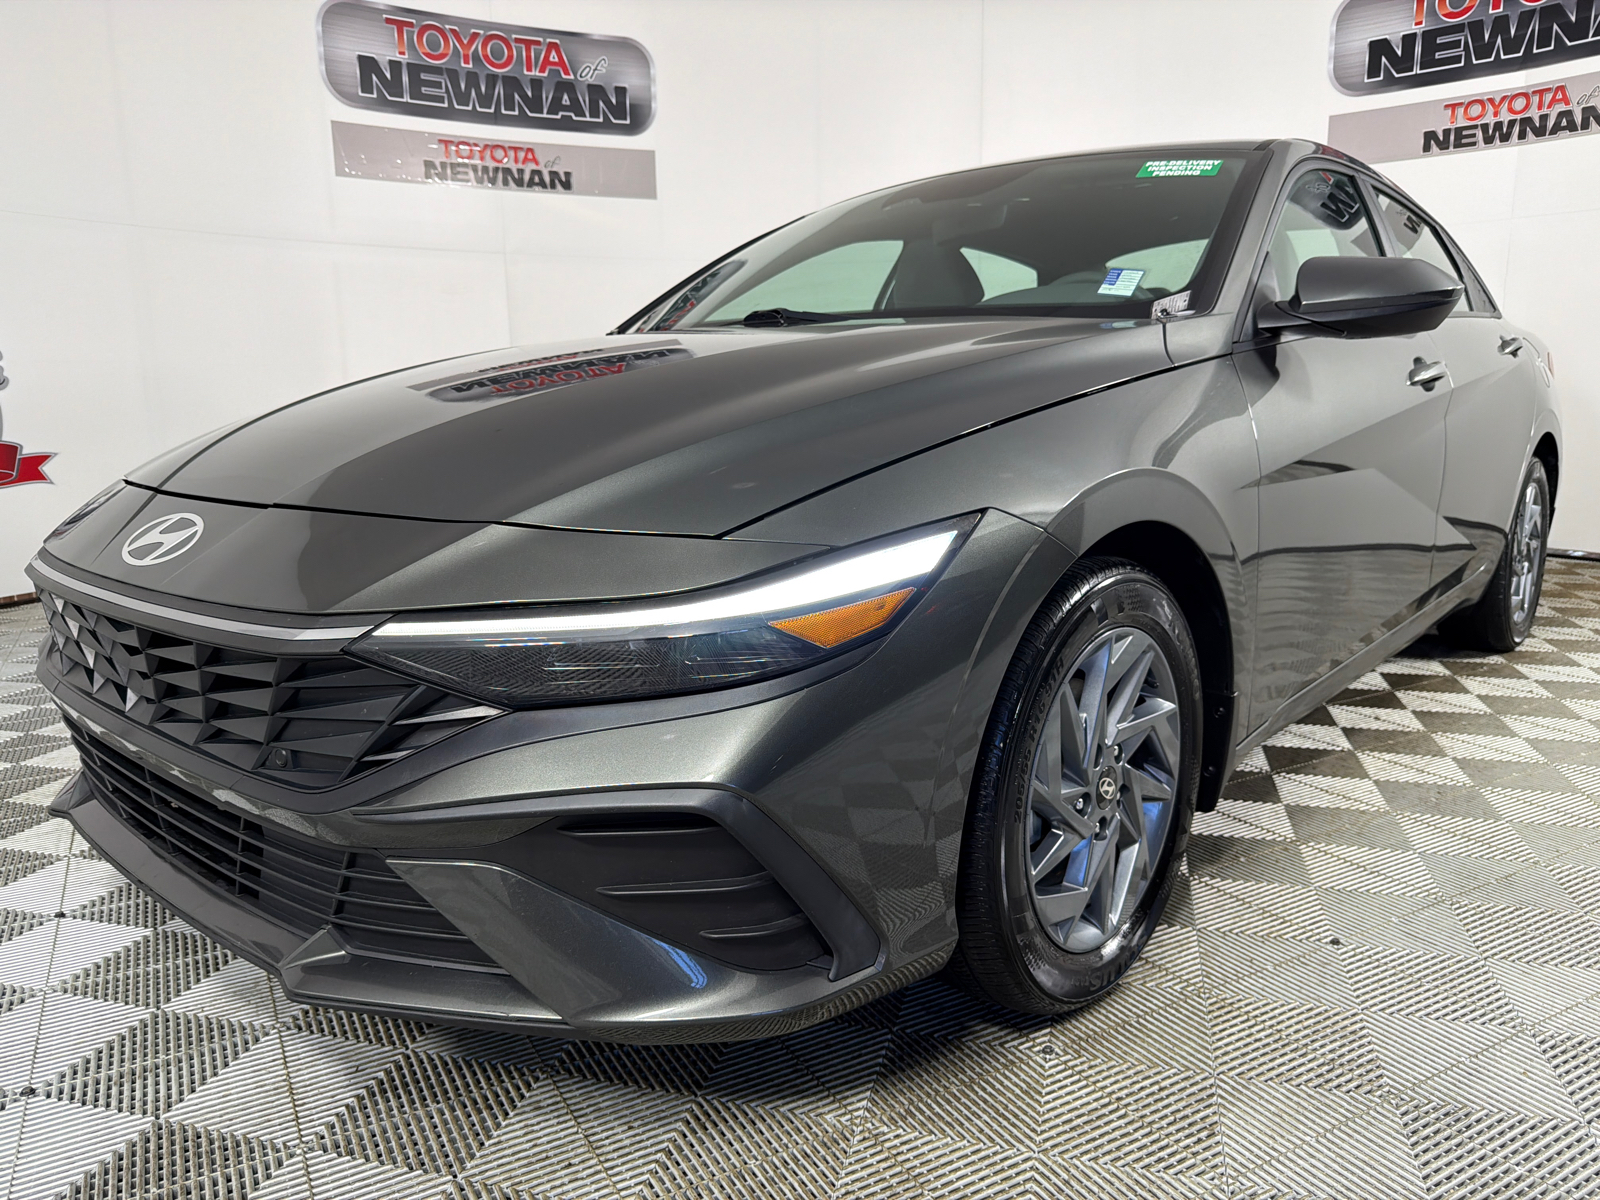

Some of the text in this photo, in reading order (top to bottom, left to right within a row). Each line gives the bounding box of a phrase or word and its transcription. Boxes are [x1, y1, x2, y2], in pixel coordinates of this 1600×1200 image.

[384, 16, 609, 81] TOYOTA of
[357, 53, 630, 123] NEWNAN
[1444, 84, 1572, 125] TOYOTA
[1422, 105, 1600, 153] NEWNAN
[423, 159, 572, 190] NEWNAN
[437, 138, 561, 169] TOYOTA of
[1145, 159, 1222, 167] PRE-DELIVERY
[1014, 747, 1032, 824] 205/55
[1029, 700, 1046, 743] R16
[1044, 655, 1064, 698] 91H
